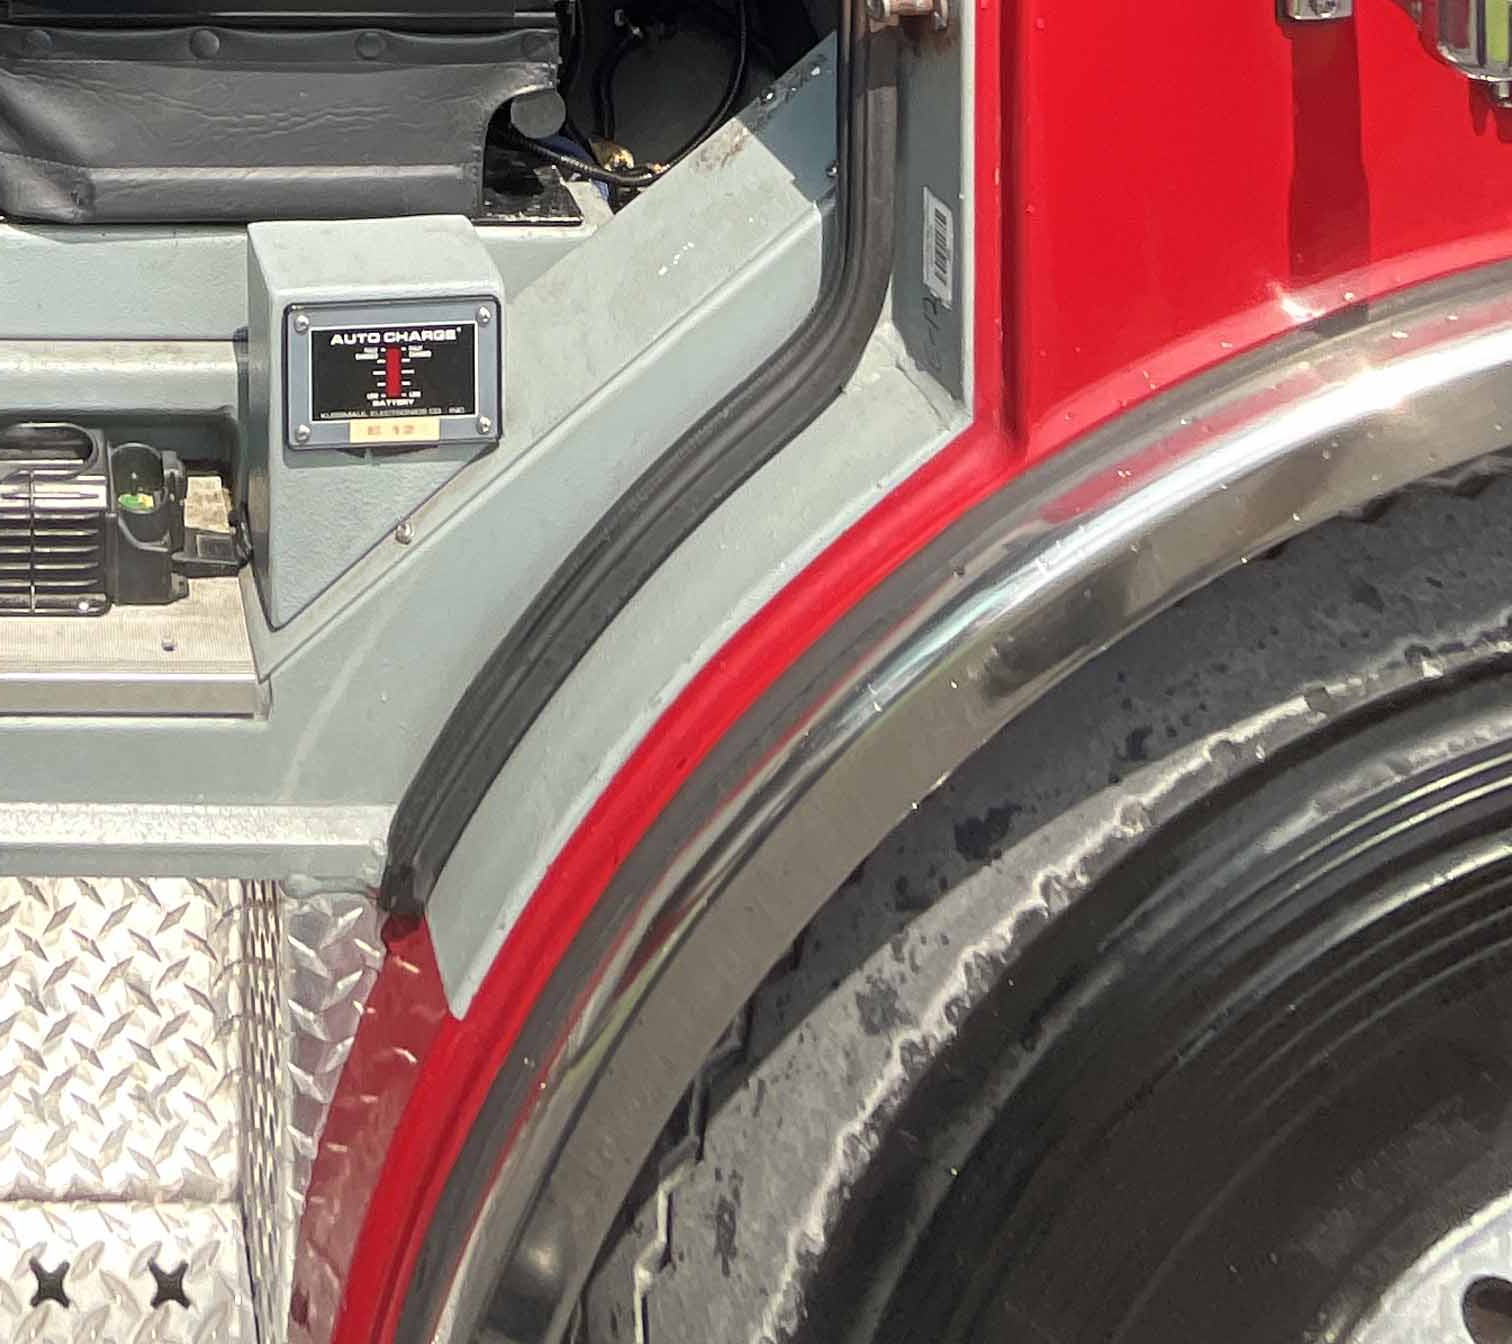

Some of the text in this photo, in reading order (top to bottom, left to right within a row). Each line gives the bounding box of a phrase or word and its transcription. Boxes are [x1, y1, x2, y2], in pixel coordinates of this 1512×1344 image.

[330, 329, 457, 346] AUTO CHARGE
[371, 399, 416, 407] BATTERY
